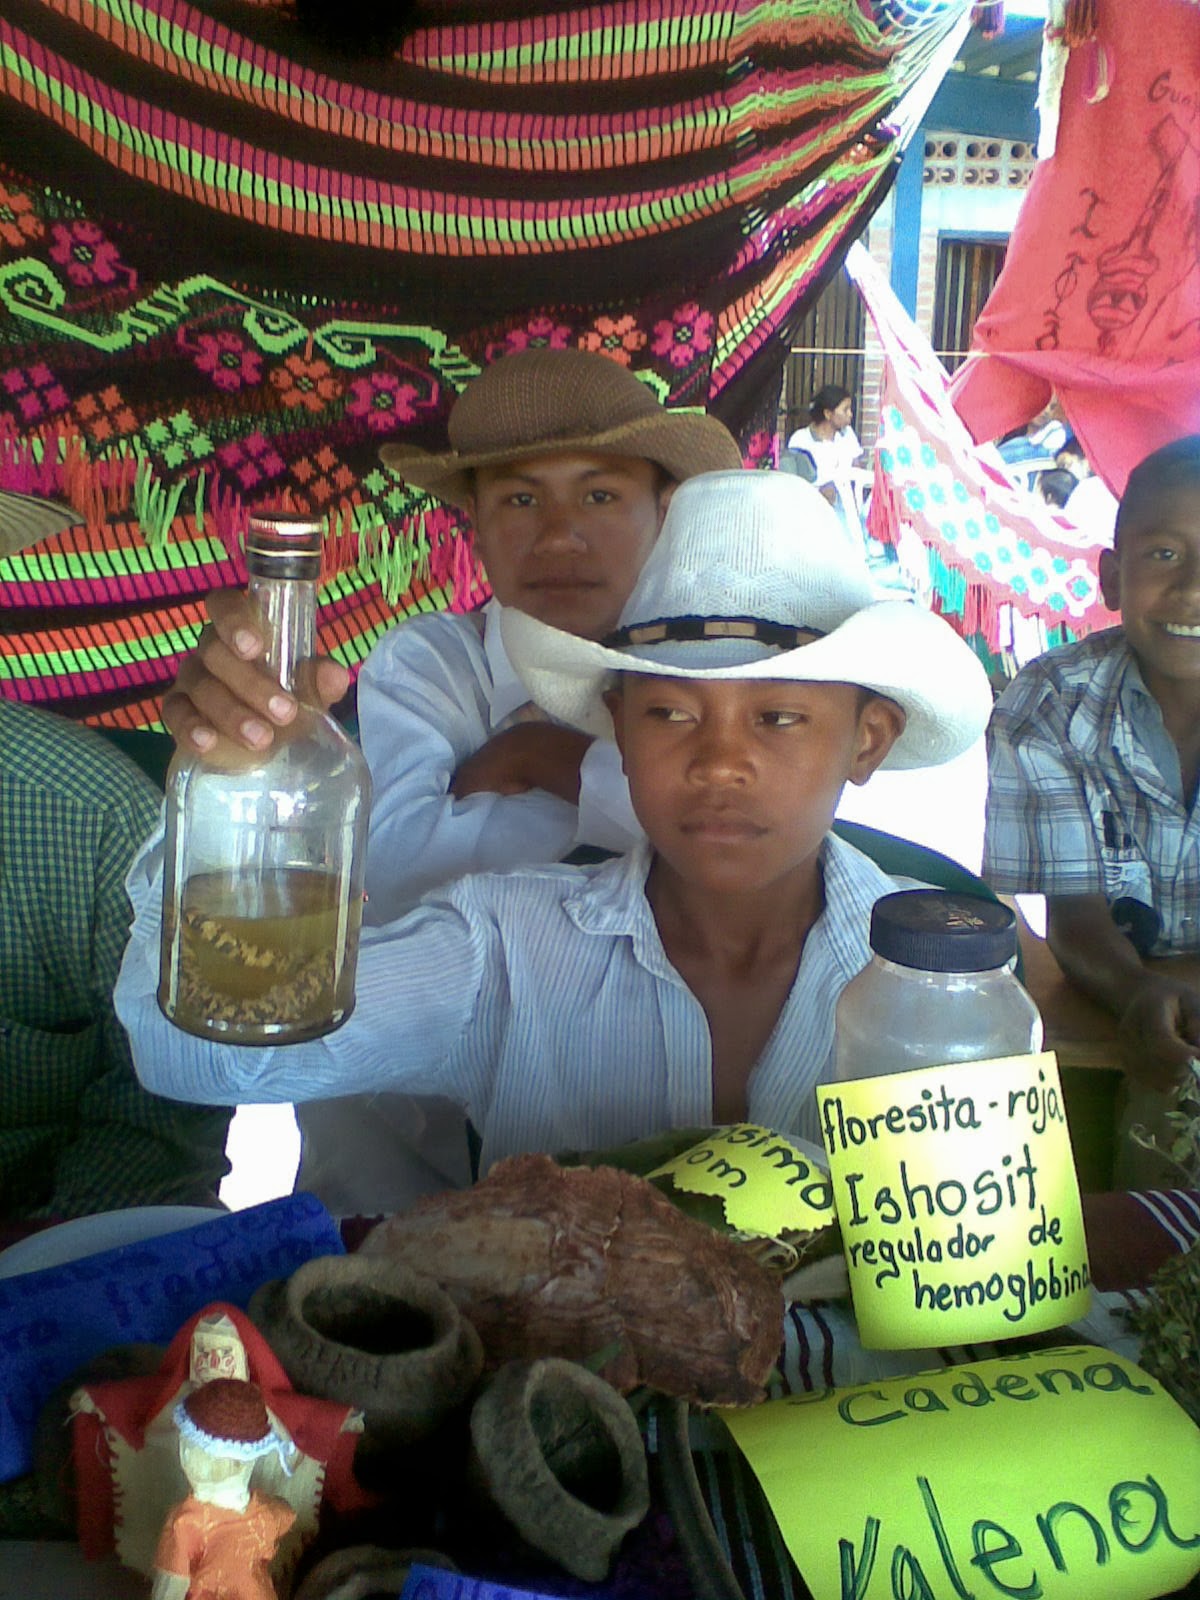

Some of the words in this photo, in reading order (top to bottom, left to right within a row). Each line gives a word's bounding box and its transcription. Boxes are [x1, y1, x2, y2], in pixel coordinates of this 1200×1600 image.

[823, 1085, 982, 1155] floresita
[849, 1222, 995, 1289] regulador
[1028, 1204, 1063, 1245] de
[837, 1361, 1155, 1426] Cadena
